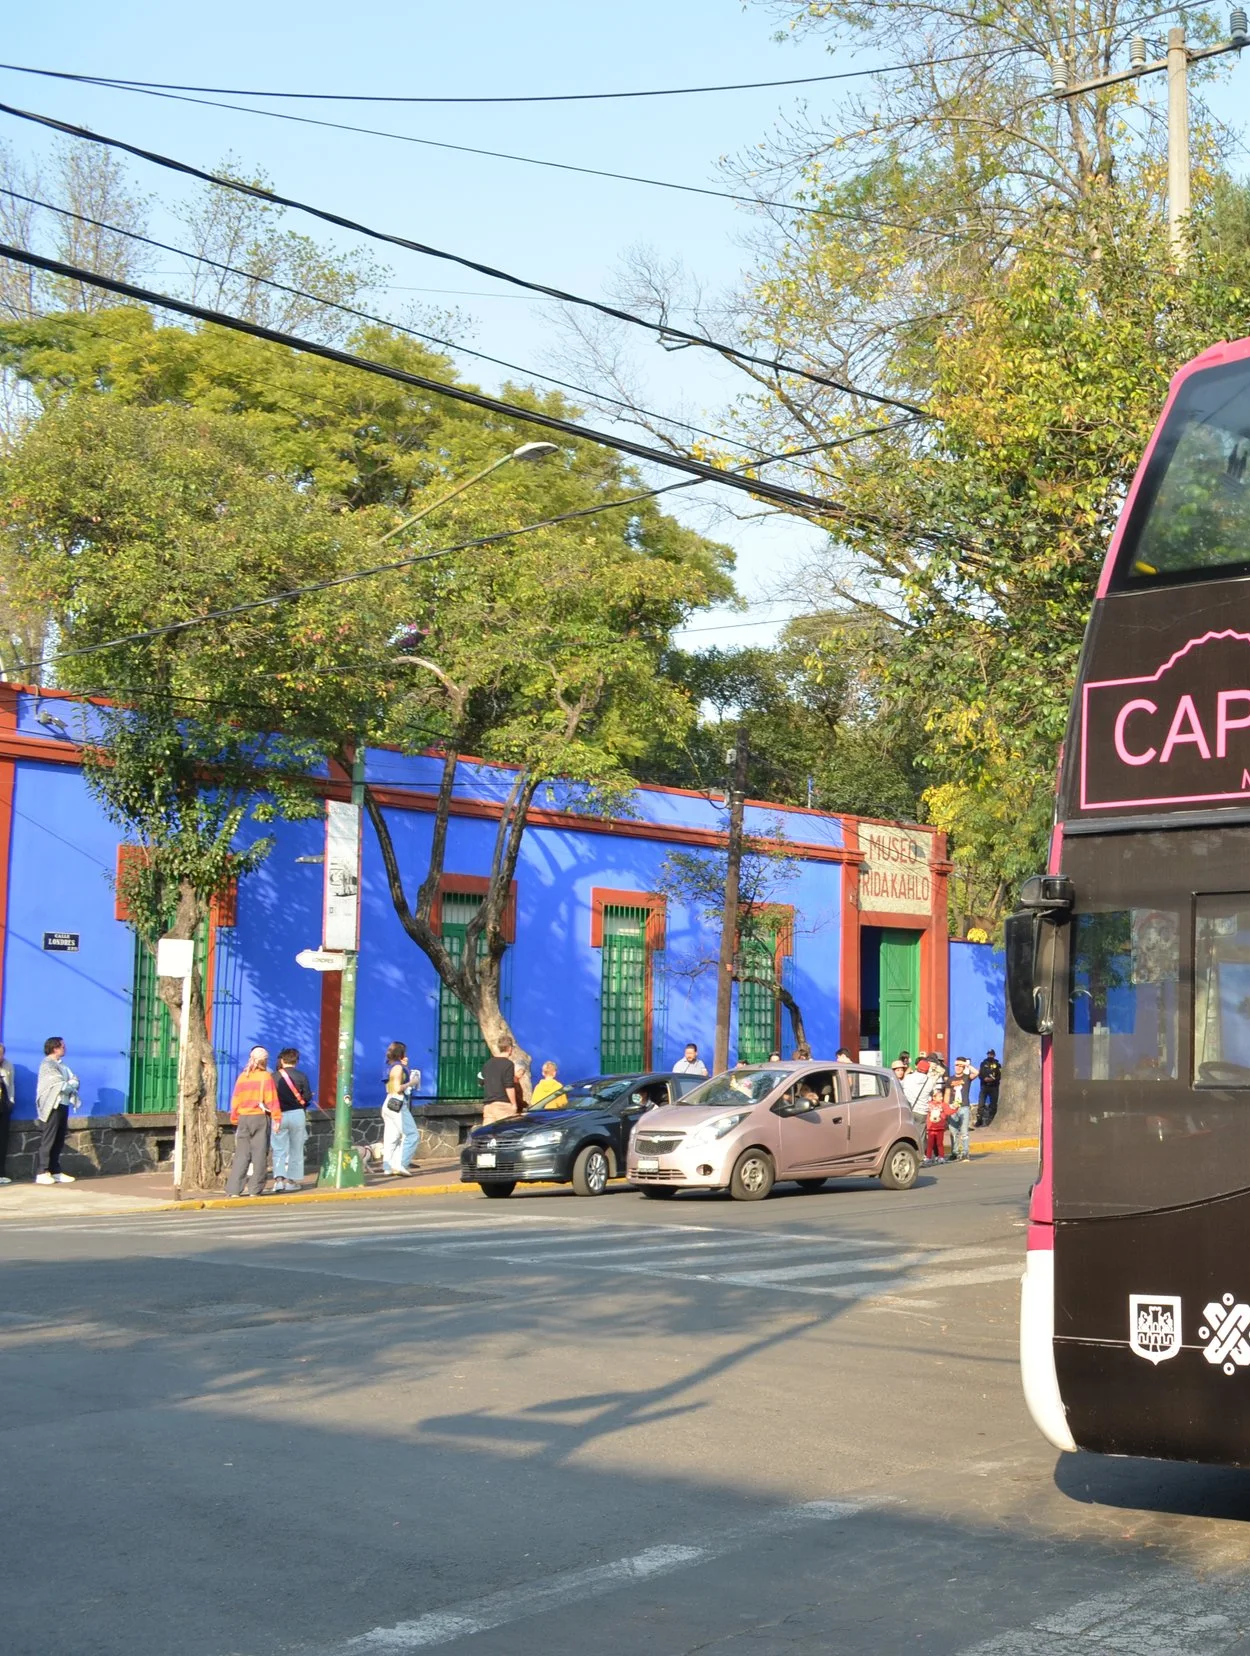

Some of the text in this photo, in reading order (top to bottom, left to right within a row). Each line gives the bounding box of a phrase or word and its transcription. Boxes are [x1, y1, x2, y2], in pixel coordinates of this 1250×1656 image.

[869, 834, 917, 865] MUSEO
[859, 871, 930, 901] RIDA KAHLO
[48, 938, 76, 946] LONDRES
